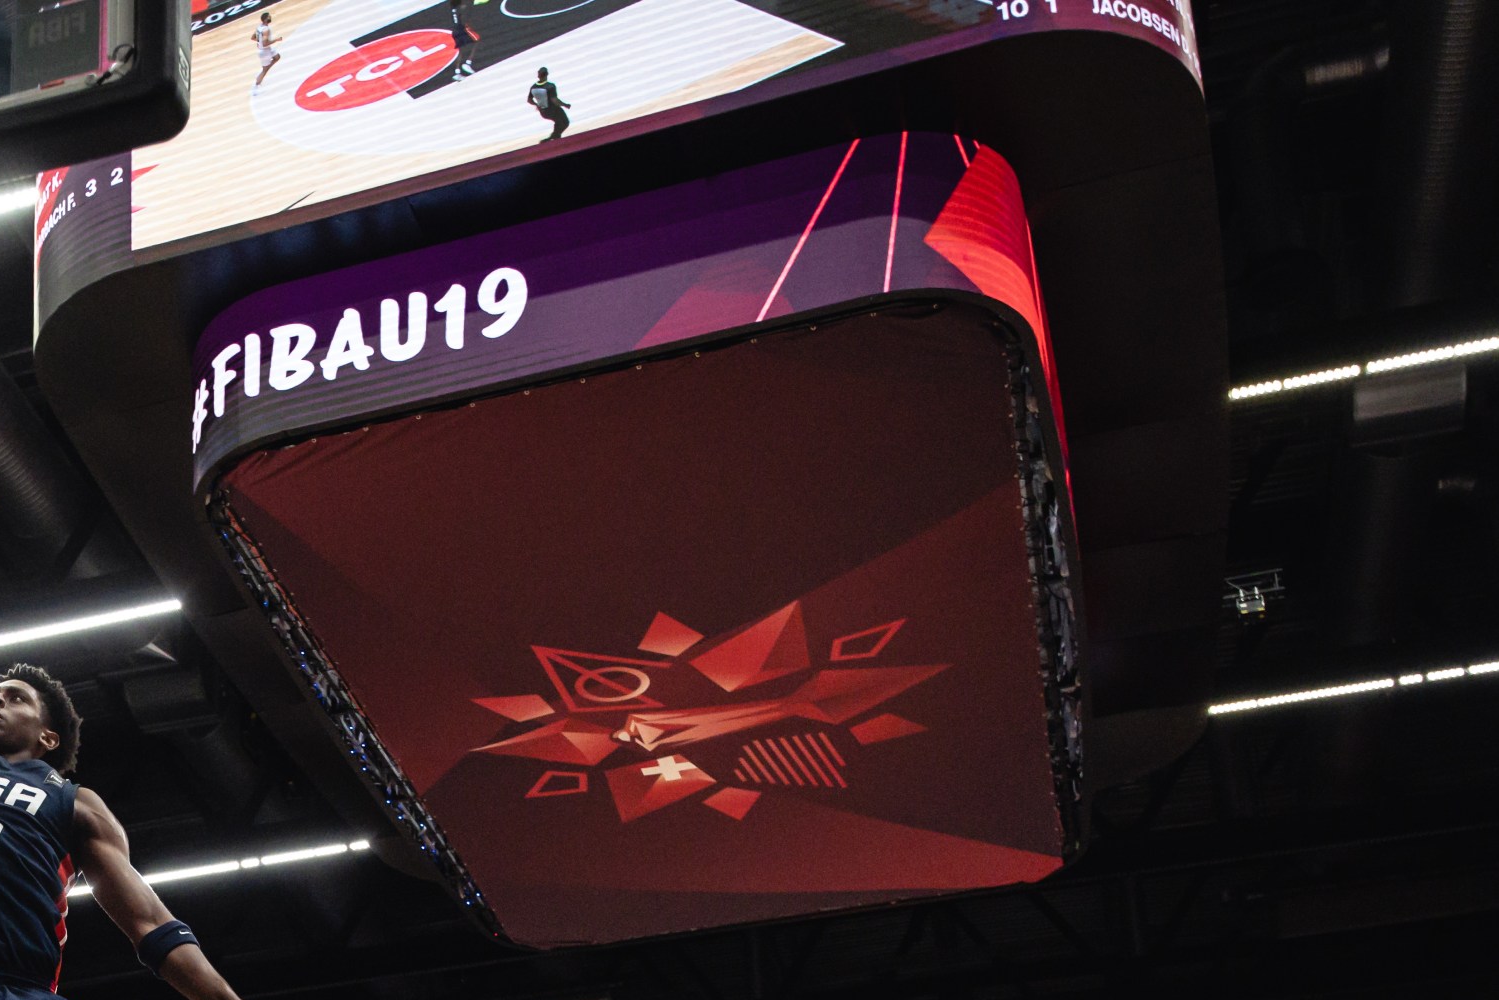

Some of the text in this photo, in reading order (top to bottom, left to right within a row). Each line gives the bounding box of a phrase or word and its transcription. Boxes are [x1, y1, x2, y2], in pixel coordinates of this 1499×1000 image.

[997, 1, 1029, 21] 10
[1092, 0, 1180, 46] JACOBSEN
[306, 39, 448, 101] TCL
[85, 178, 97, 197] 3
[110, 167, 124, 186] 2
[192, 267, 528, 453] #FIBAU19
